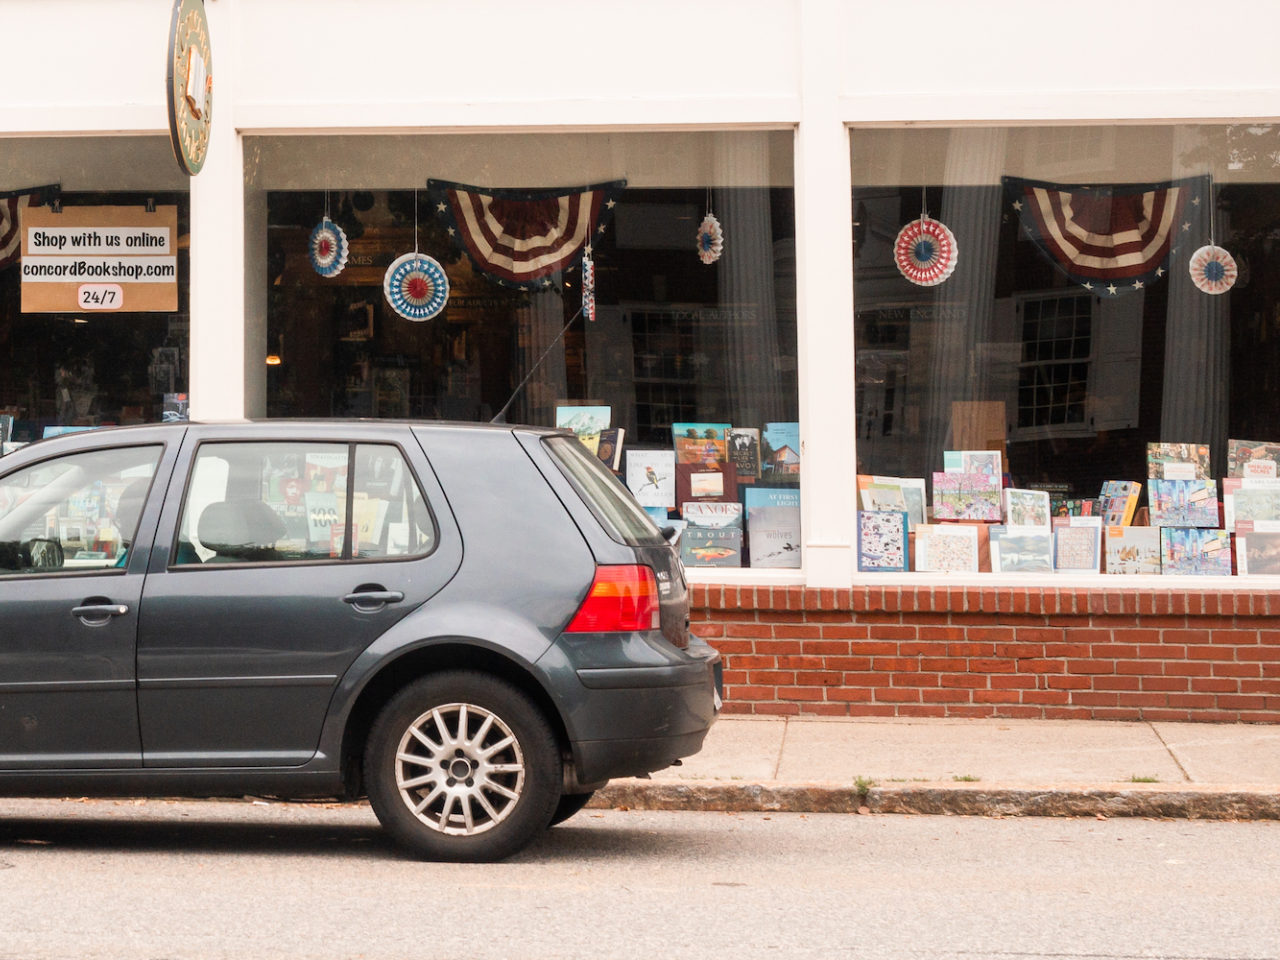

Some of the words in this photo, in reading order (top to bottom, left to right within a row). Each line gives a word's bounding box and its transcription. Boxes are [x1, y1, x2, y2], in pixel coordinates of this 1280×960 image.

[33, 231, 67, 250] Shop
[71, 232, 101, 247] with
[105, 235, 121, 247] us
[125, 232, 166, 247] online
[23, 261, 175, 280] concordBookshop.com
[83, 290, 116, 305] 24/7
[879, 309, 905, 320] NEW
[910, 308, 967, 320] ENGLAND
[685, 503, 740, 515] CANOES
[766, 531, 793, 540] wolves
